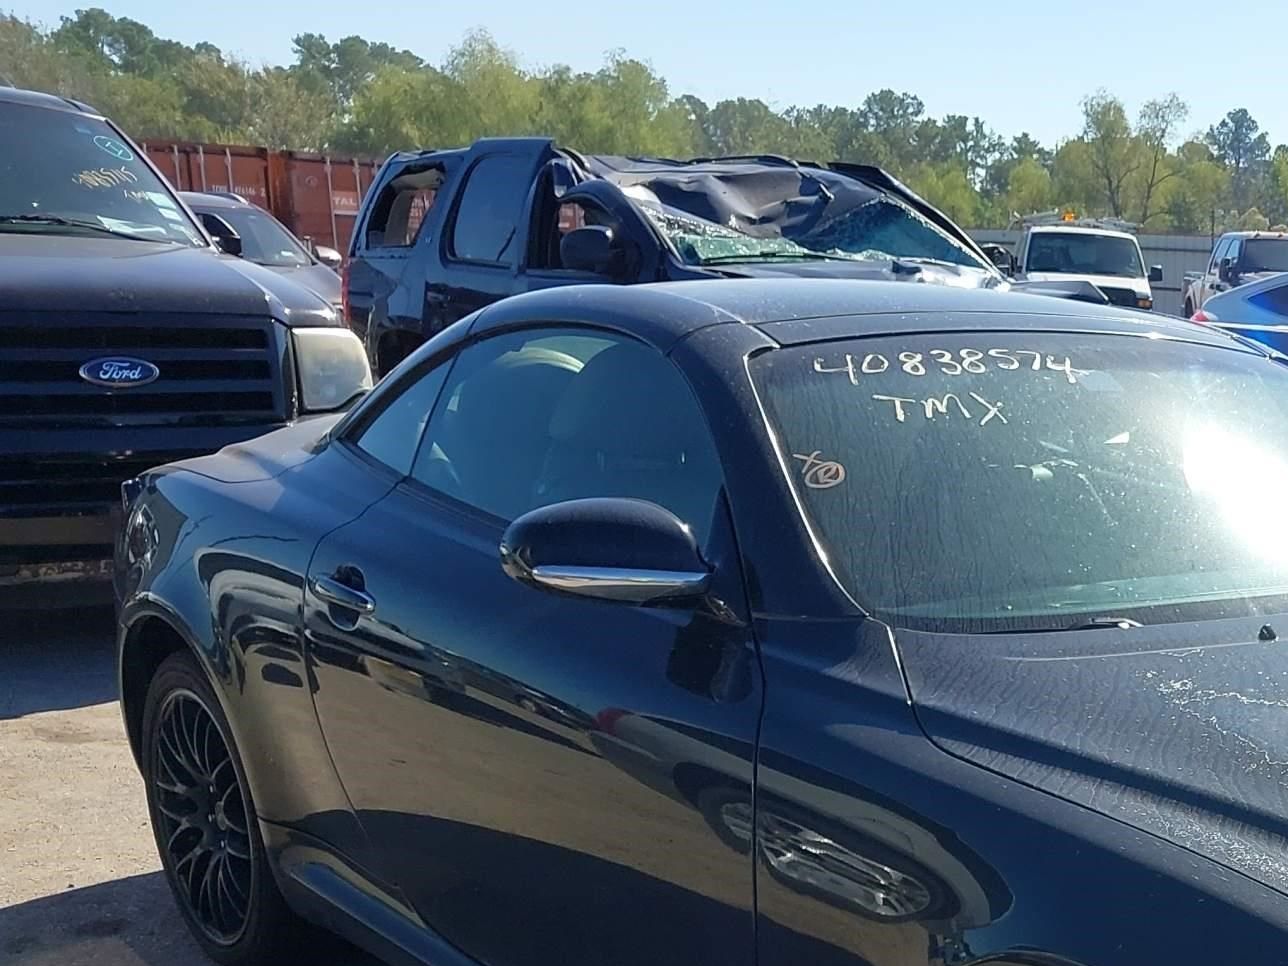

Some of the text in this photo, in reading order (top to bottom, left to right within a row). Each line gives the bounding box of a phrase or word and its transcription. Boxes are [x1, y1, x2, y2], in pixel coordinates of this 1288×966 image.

[99, 361, 142, 379] Ford
[814, 348, 1090, 385] 40838574
[872, 391, 1009, 426] TMX
